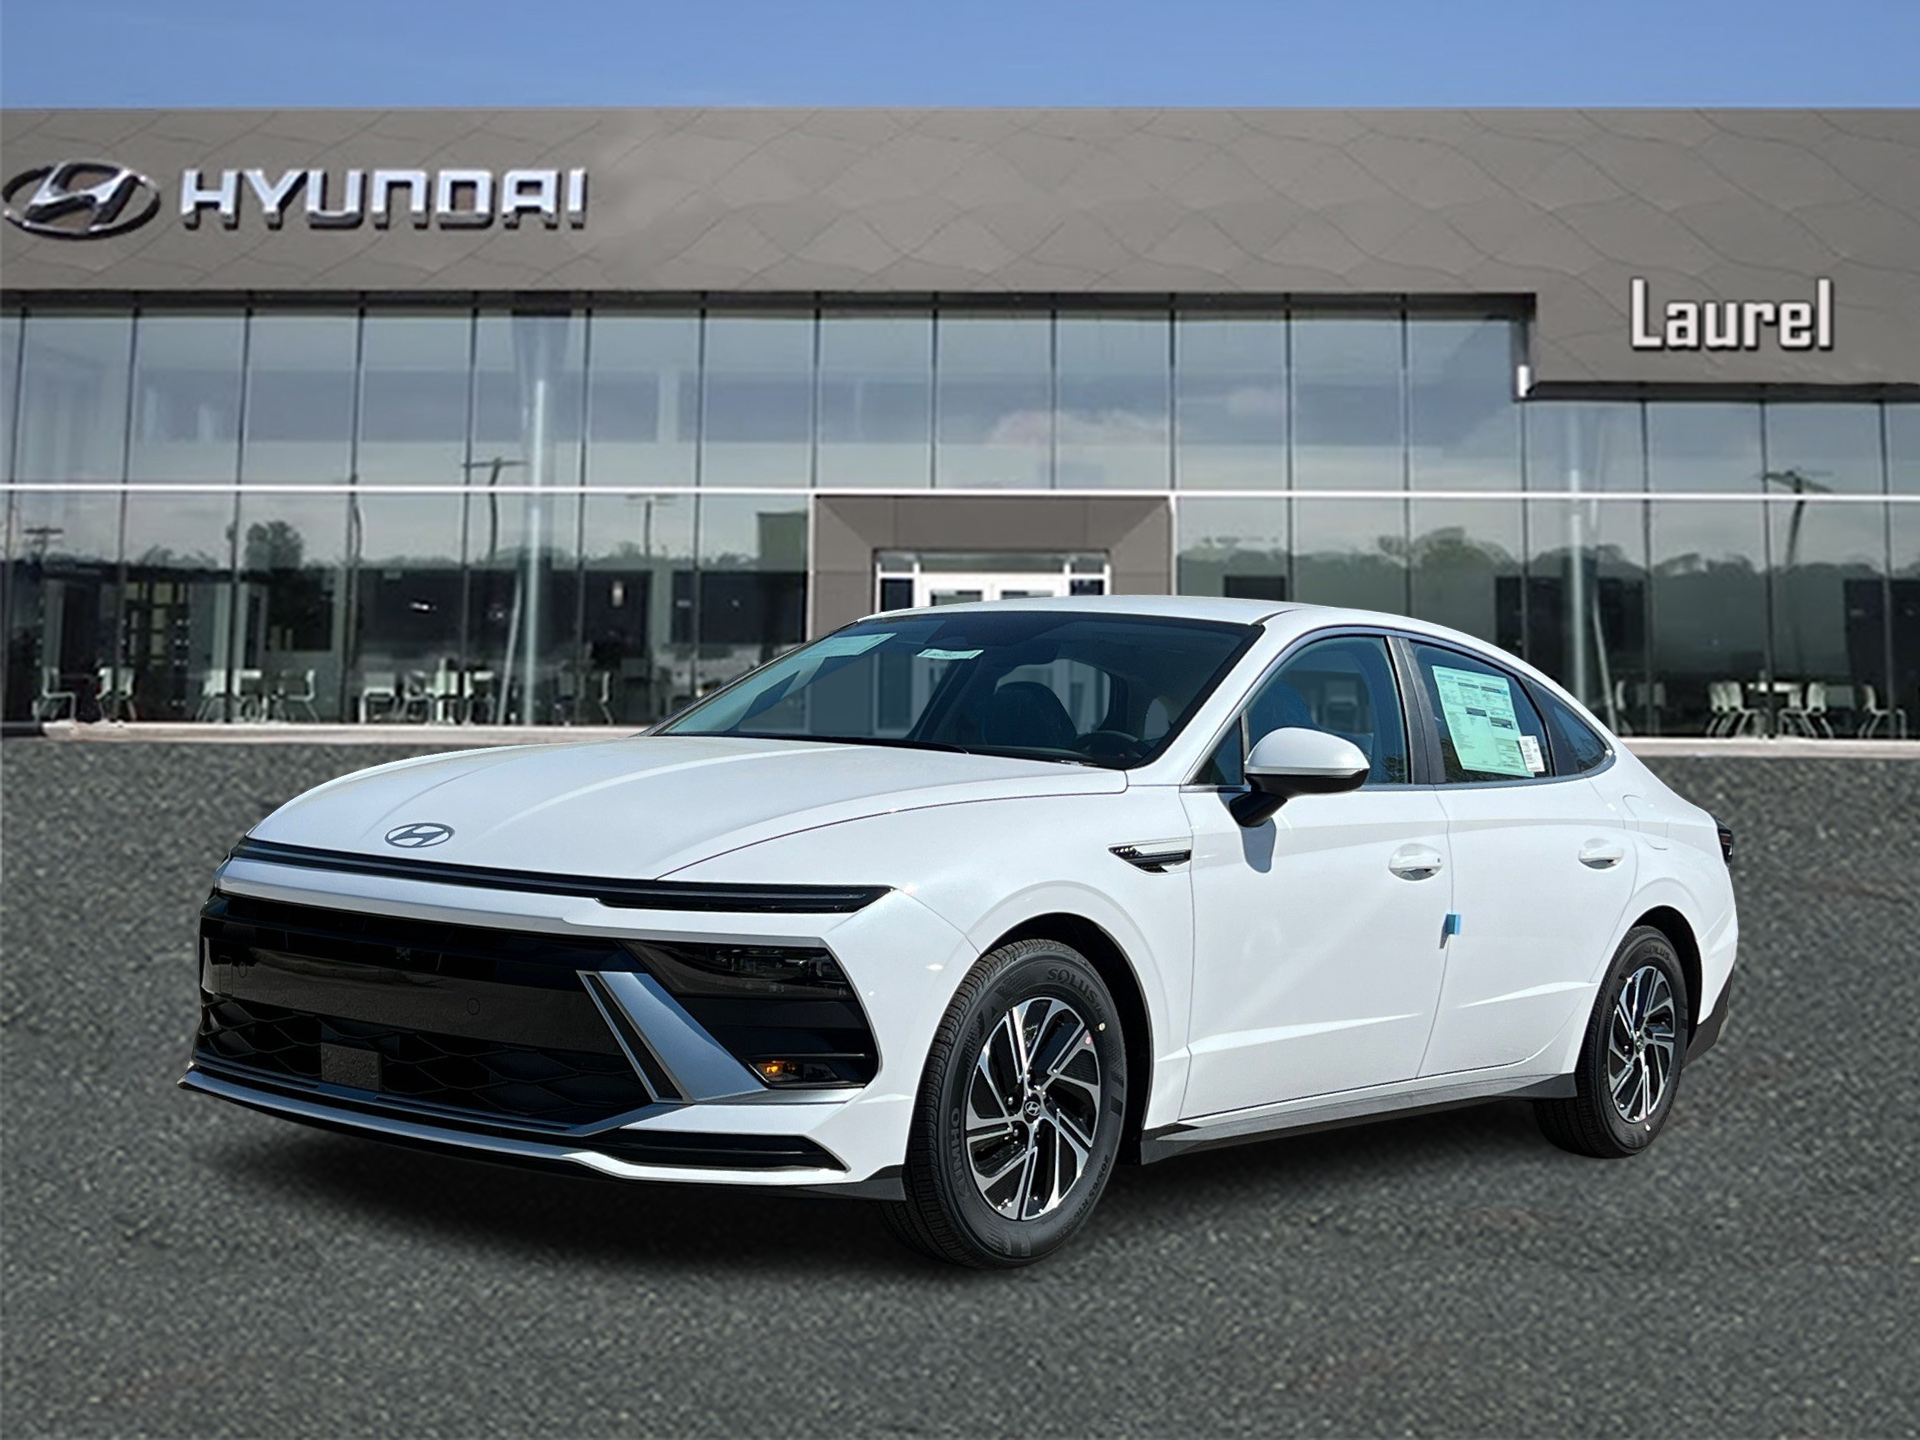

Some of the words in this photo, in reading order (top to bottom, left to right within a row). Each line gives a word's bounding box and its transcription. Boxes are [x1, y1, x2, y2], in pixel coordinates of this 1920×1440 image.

[180, 169, 588, 230] HYUNDAI
[1631, 278, 1832, 348] Laurel
[1047, 967, 1098, 1003] SOLUS
